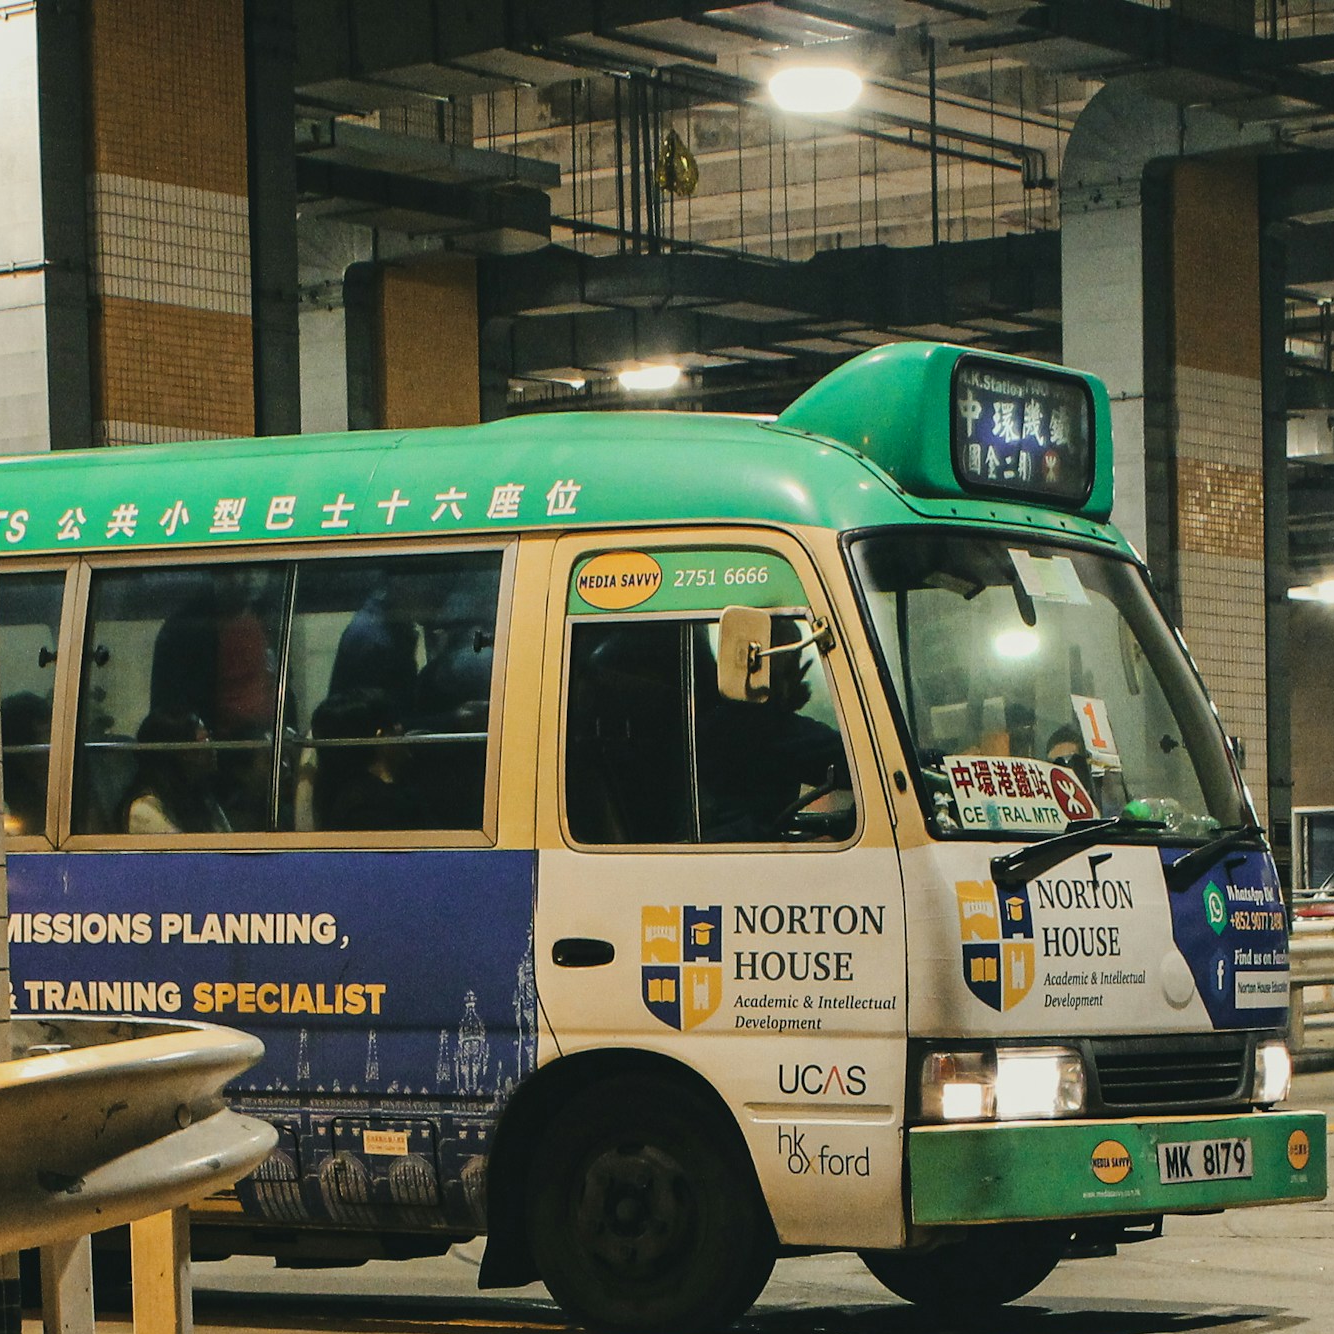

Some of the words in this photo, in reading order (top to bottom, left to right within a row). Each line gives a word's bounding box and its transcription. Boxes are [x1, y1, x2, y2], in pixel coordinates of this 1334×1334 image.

[57, 479, 581, 541] 公共小型巴士十六座位
[579, 575, 617, 589] MEDIA
[621, 573, 659, 588] SAVVY
[674, 570, 716, 587] 2751
[724, 566, 768, 585] 6666
[1083, 702, 1107, 749] 1
[951, 760, 1053, 800] 中環港鐵站
[963, 805, 1031, 827] CETRAL
[1032, 807, 1062, 824] MTR
[1035, 879, 1134, 909] NORTON
[161, 912, 351, 950] PLANNING,
[733, 904, 886, 935] NORTON
[1042, 926, 1121, 957] HOUSE
[733, 951, 854, 981] HOUSE
[1044, 971, 1089, 986] Academic
[1091, 971, 1098, 985] &
[1100, 970, 1146, 985] Intellectual
[24, 980, 181, 1013] TRAINING
[193, 982, 387, 1015] SPECIALIST
[734, 994, 798, 1009] Academic
[803, 995, 814, 1009] &
[818, 995, 897, 1010] Intellectual
[1044, 992, 1103, 1011] Development
[735, 1015, 822, 1032] Development
[778, 1064, 866, 1095] UCAS
[788, 1145, 870, 1176] oxford
[1165, 1144, 1193, 1178] MK
[1204, 1139, 1245, 1176] 8179
